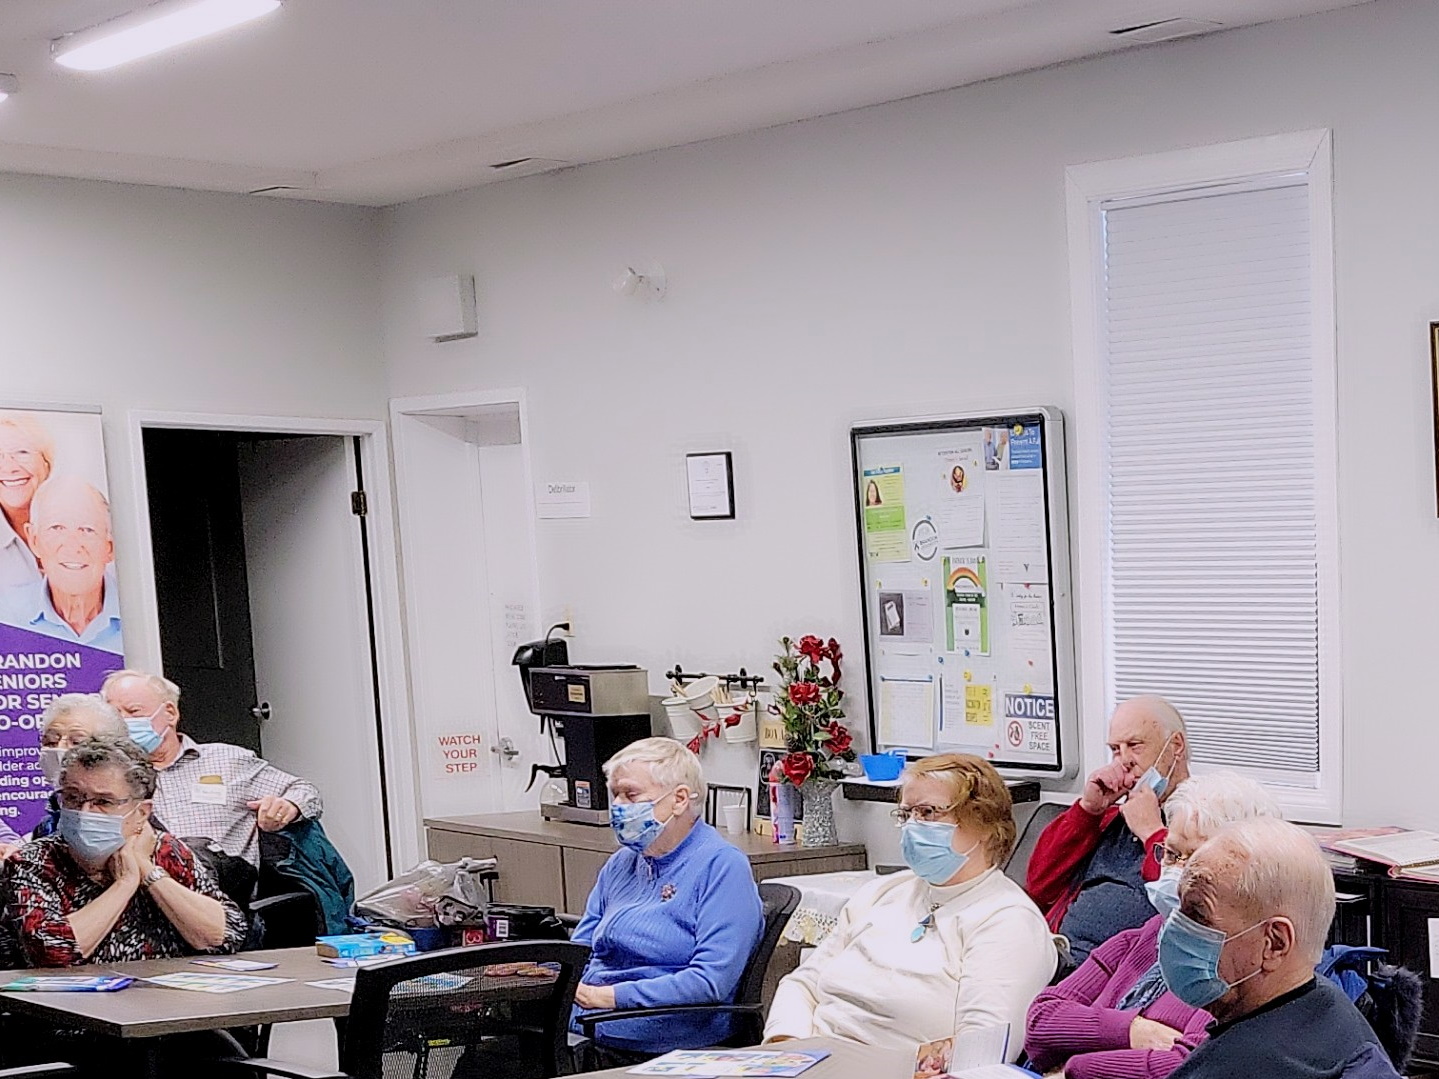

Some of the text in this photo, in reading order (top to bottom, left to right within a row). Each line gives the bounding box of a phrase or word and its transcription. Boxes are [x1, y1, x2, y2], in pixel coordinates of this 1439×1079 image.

[0, 673, 68, 690] NIORS
[1005, 696, 1055, 717] NOTICE
[1028, 721, 1051, 731] SCENT
[438, 734, 481, 746] WATCH
[1030, 731, 1049, 741] FREE
[1028, 741, 1051, 751] SPACE
[443, 748, 477, 759] YOUR
[0, 760, 23, 771] lder
[445, 762, 477, 773] STEP
[0, 776, 29, 787] ding
[0, 806, 20, 817] ng.
